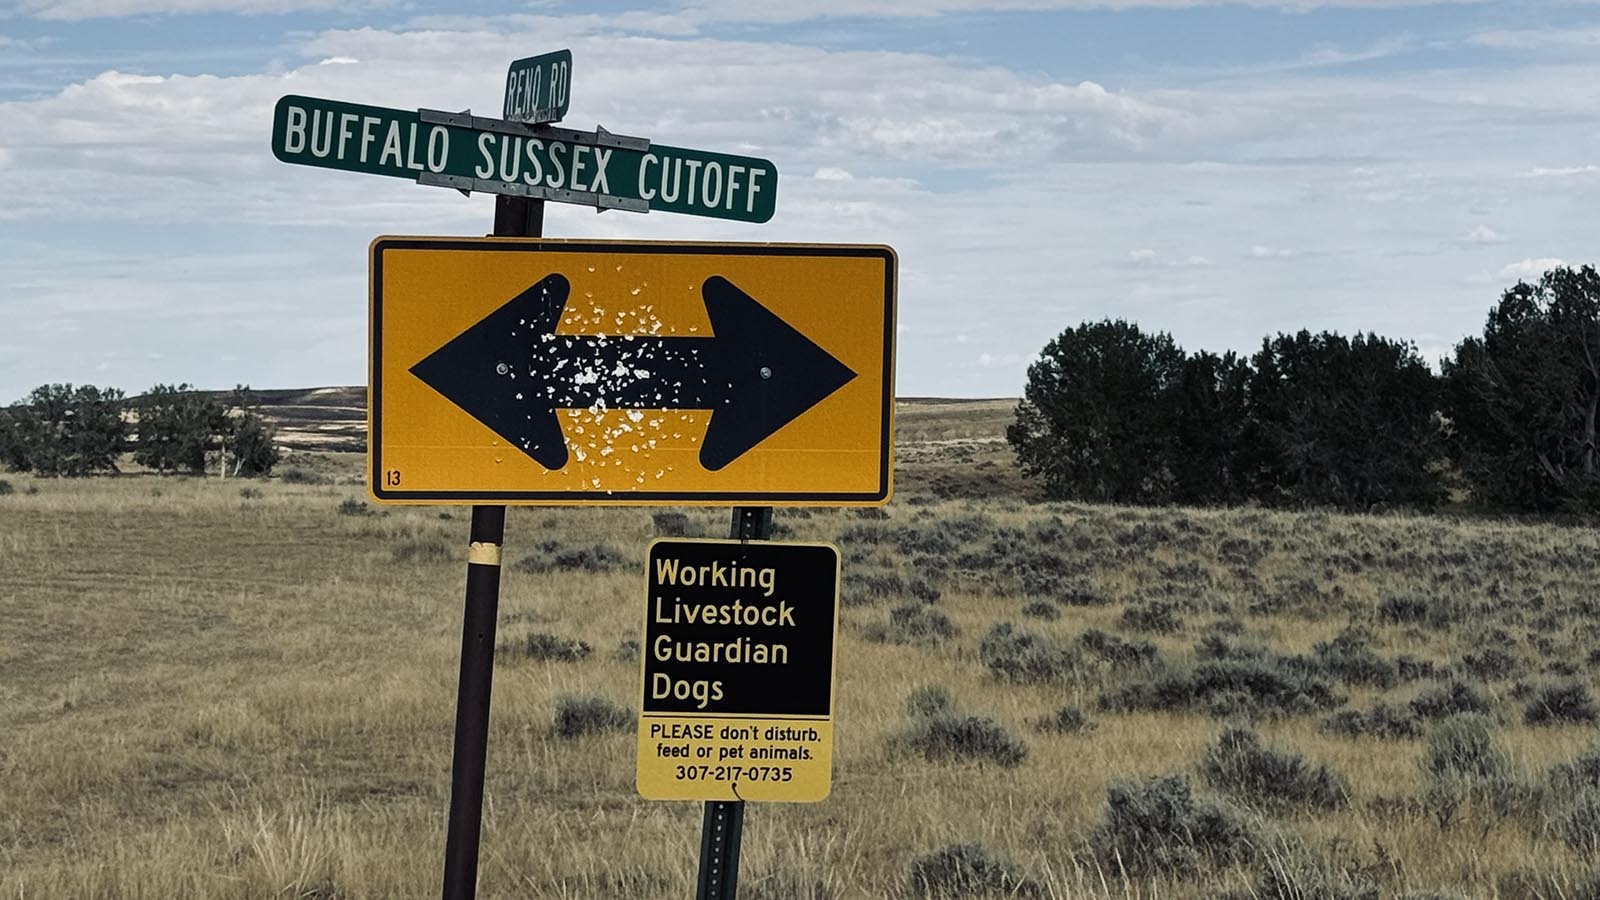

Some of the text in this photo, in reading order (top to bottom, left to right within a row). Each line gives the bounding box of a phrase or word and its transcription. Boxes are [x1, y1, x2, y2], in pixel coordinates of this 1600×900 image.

[506, 60, 567, 115] RENO RD
[284, 105, 766, 212] BUFFALO SUSSEX CUTOFF
[387, 470, 401, 486] 13
[656, 558, 776, 597] Working
[655, 597, 796, 626] Livestock
[654, 634, 788, 664] Guardian
[652, 672, 724, 709] Dogs
[650, 724, 714, 739] PLEASE
[720, 726, 759, 740] don't
[657, 743, 813, 761] feed or pet animals.
[675, 765, 793, 782] 307-217-0735
